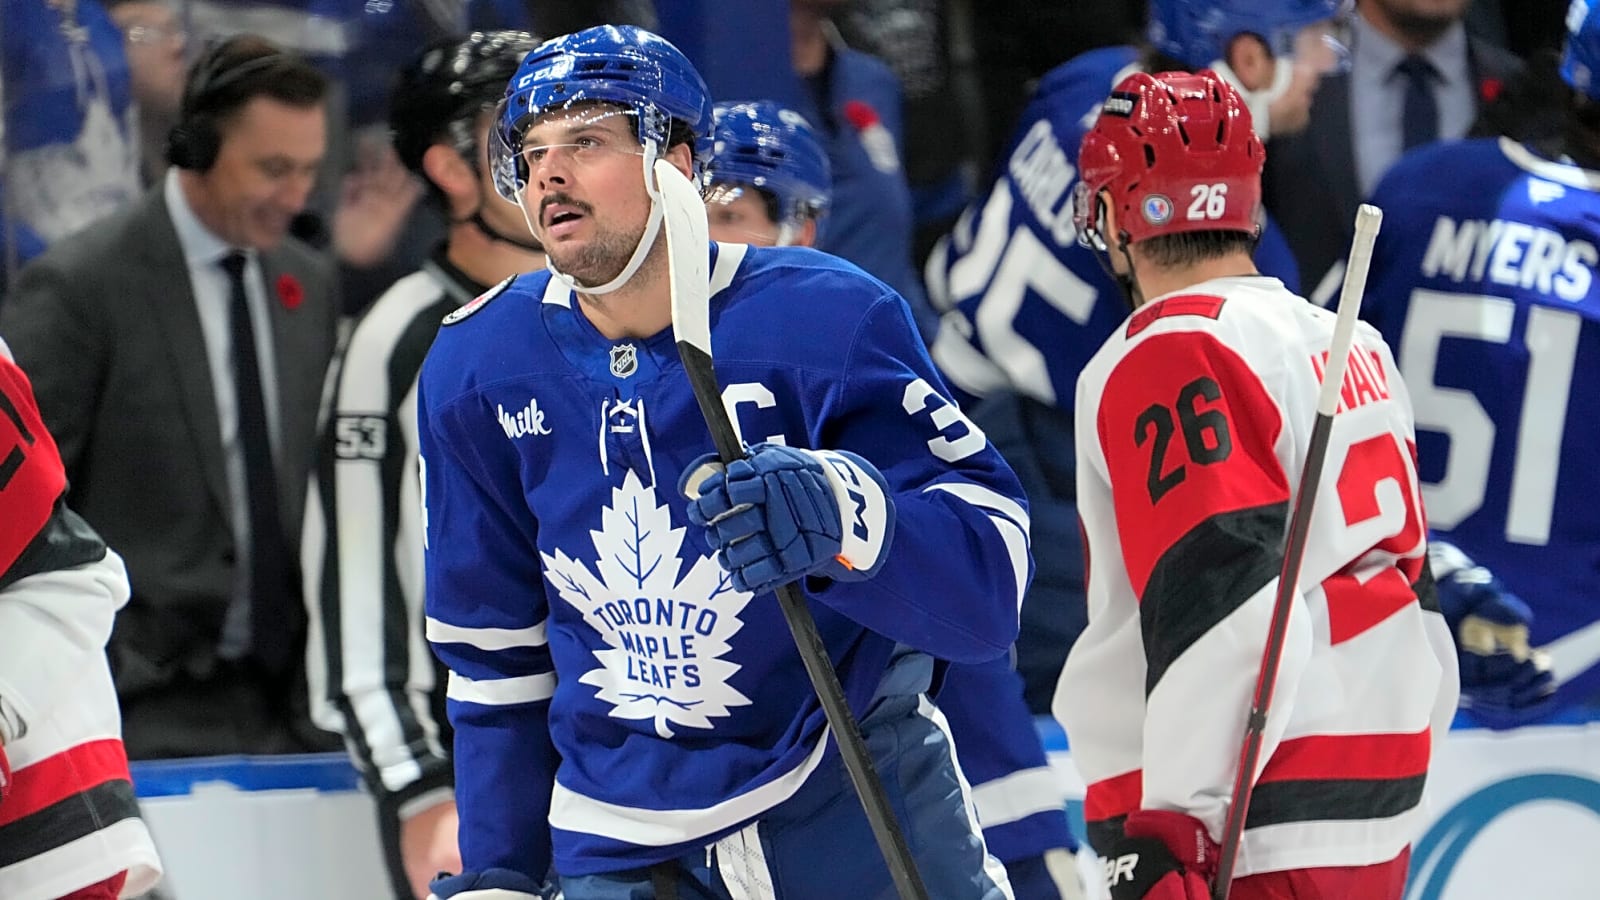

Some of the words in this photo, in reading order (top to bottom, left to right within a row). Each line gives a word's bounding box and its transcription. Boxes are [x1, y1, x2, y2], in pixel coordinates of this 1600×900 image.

[1187, 183, 1227, 221] 26
[1421, 215, 1598, 303] MYERS
[721, 382, 786, 447] C
[1401, 288, 1582, 546] 51
[335, 417, 386, 459] 53
[1134, 376, 1232, 506] 26
[593, 597, 718, 637] TORONTO
[618, 630, 697, 660] MAPLE
[627, 655, 701, 689] LEAFS
